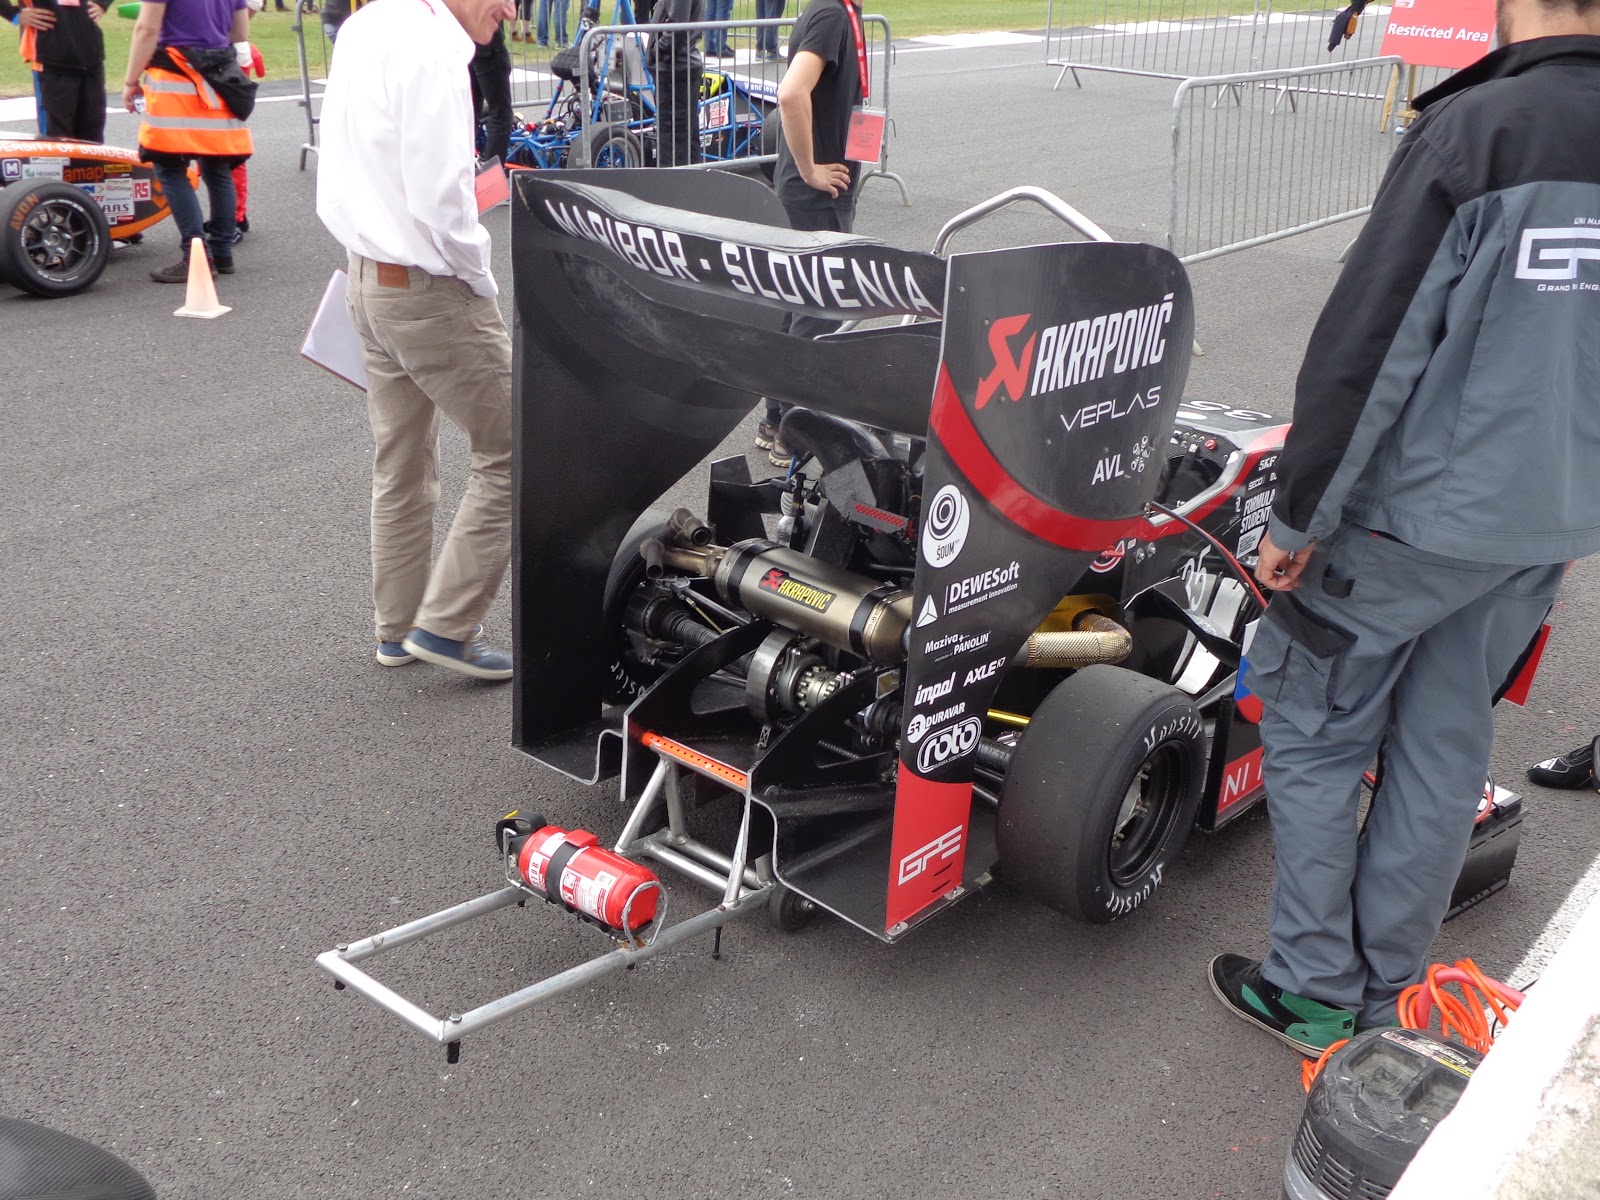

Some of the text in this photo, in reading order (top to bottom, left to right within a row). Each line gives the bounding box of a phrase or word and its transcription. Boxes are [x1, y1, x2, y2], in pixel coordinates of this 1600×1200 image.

[1387, 22, 1489, 42] Restricted Area
[0, 141, 53, 153] ERSITY
[63, 165, 104, 183] amap
[9, 193, 39, 232] AVON
[545, 199, 700, 283] MARIBOR
[720, 241, 942, 317] SLOVENIA
[1060, 386, 1162, 432] VEPLAS
[1091, 453, 1125, 486] AVL
[1258, 455, 1278, 472] SKF
[1243, 488, 1276, 517] FORMULA
[1240, 504, 1272, 534] STUDENT
[949, 560, 1020, 604] DEWESoft
[948, 582, 1018, 615] measurement innovation
[953, 633, 989, 656] PANOLIN
[925, 701, 966, 729] DURAVAR
[923, 723, 978, 769] roto
[1222, 762, 1251, 804] NI
